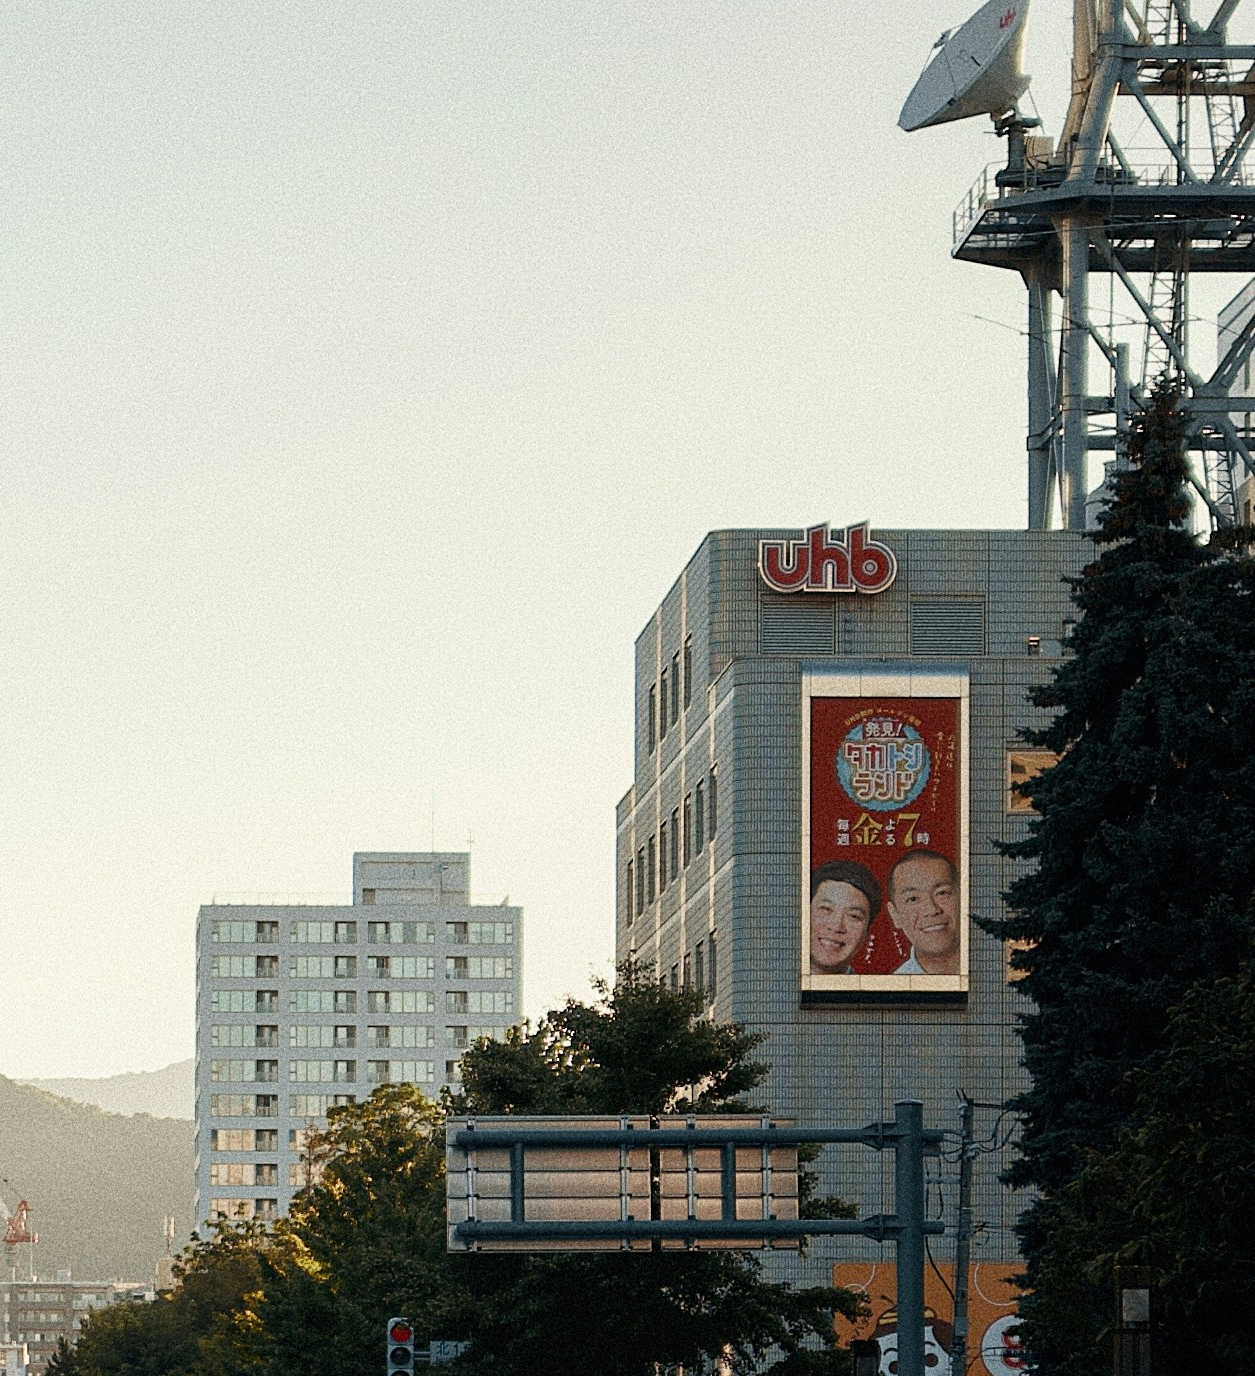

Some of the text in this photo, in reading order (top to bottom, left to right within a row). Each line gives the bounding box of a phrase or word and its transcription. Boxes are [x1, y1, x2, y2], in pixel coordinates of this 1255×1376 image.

[760, 522, 897, 593] uhb
[845, 742, 923, 772] タカトシ
[852, 771, 914, 801] ランド
